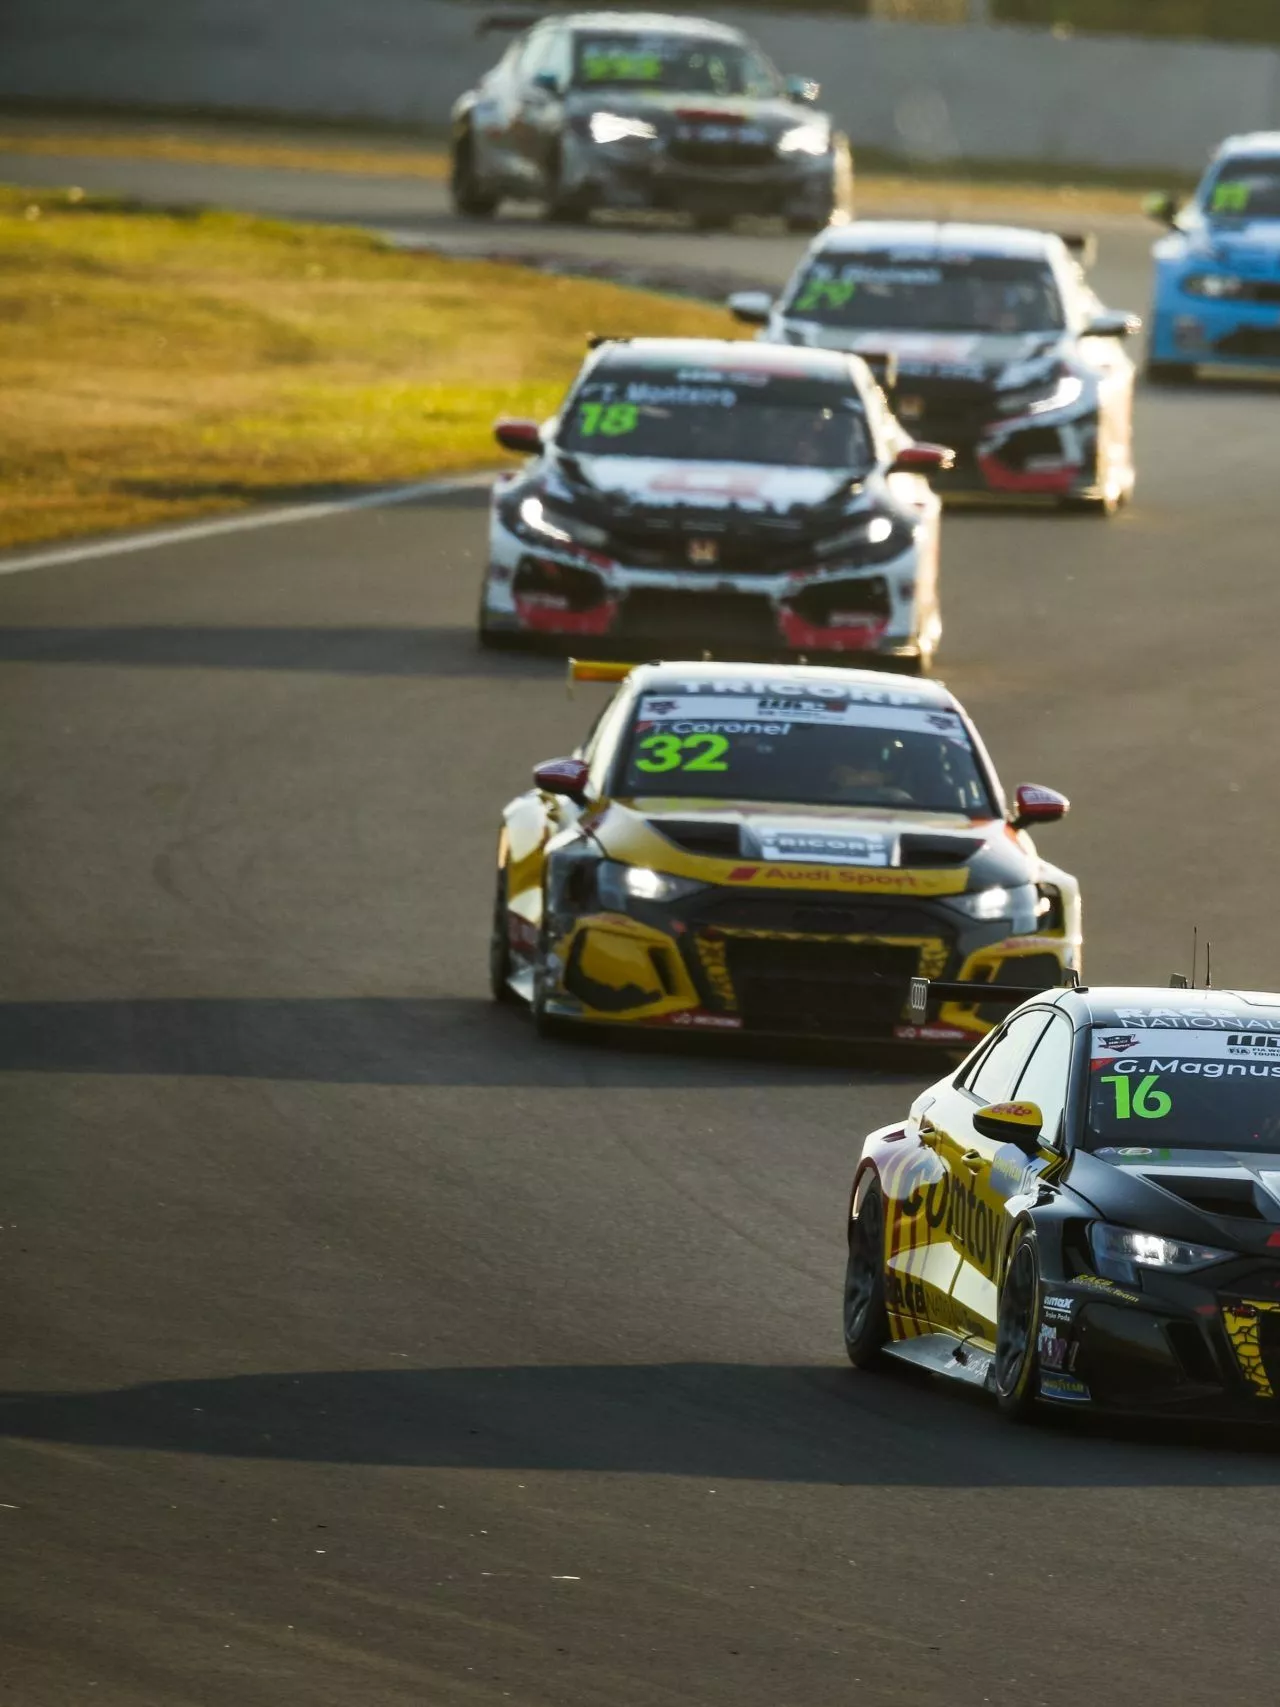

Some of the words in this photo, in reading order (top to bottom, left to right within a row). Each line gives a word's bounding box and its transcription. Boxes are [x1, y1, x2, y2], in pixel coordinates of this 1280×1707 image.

[579, 403, 638, 437] 18
[635, 733, 729, 773] 32
[762, 836, 886, 851] TRICORP
[765, 868, 829, 881] Audi
[839, 871, 917, 887] Sport
[1100, 1075, 1172, 1119] 16
